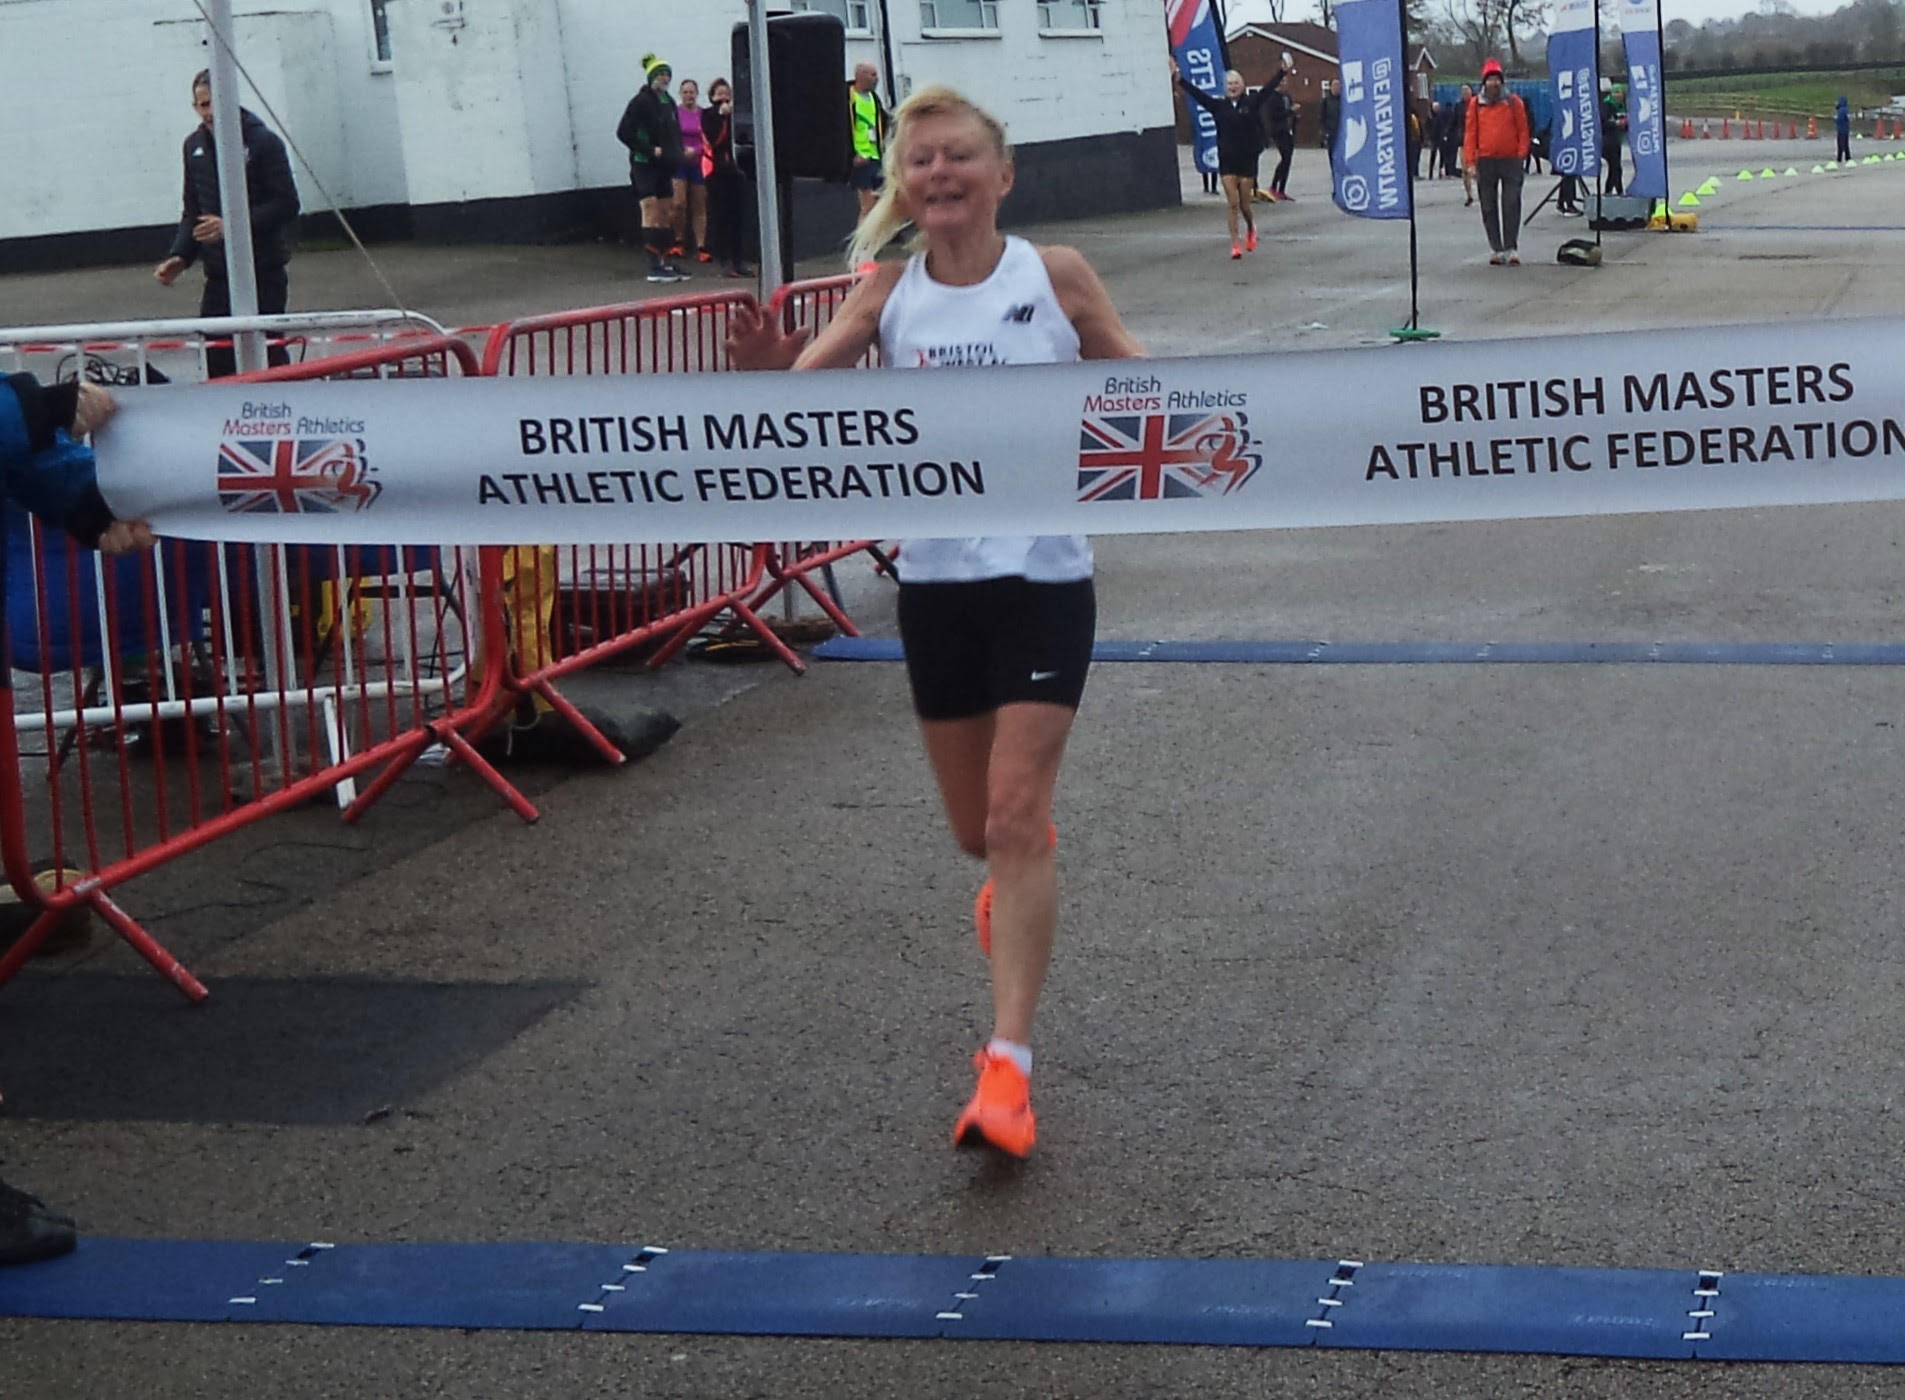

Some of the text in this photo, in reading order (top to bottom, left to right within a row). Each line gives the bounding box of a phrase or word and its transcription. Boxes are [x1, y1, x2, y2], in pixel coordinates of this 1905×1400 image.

[1083, 389, 1248, 413] Masters Athletics
[1104, 375, 1162, 395] British
[1419, 362, 1854, 424] BRITISH MASTERS
[223, 416, 365, 437] Masters Athletics
[241, 401, 292, 419] British
[519, 408, 919, 456] BRITISH MASTERS
[1365, 418, 1905, 482] ATHLETIC FEDERATION
[478, 461, 985, 505] ATHLETIC FEDERATION
